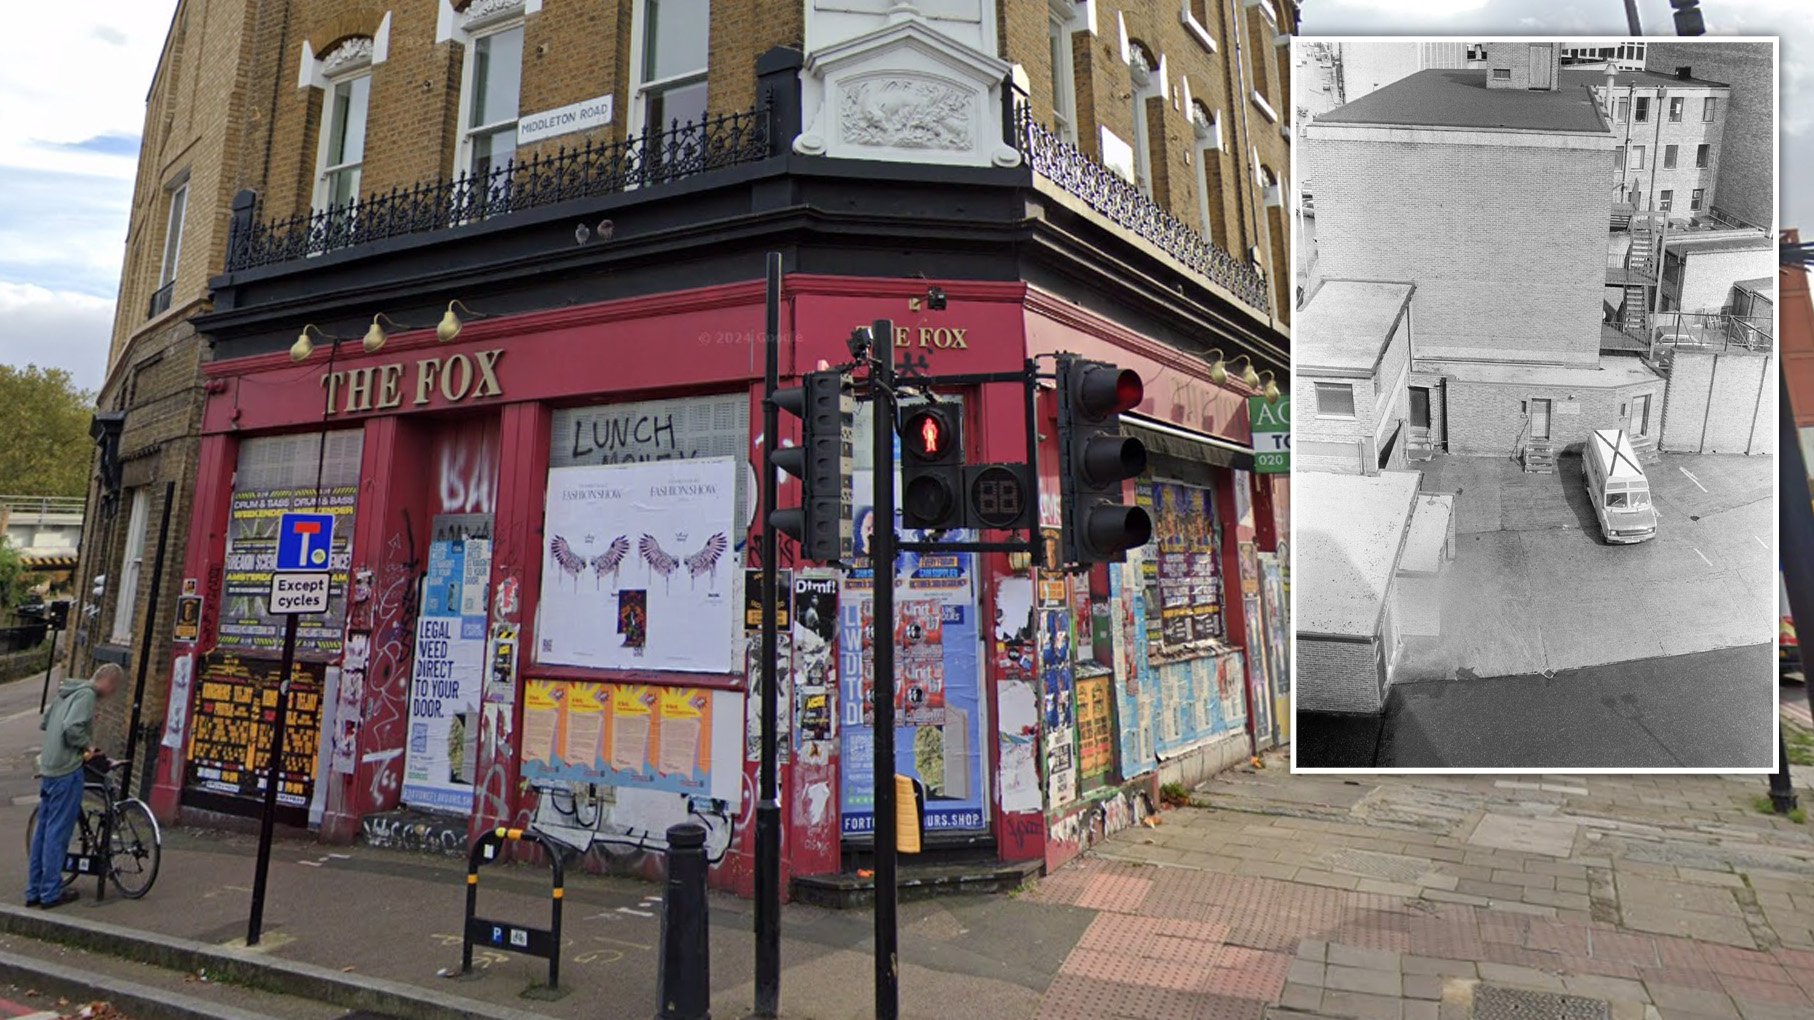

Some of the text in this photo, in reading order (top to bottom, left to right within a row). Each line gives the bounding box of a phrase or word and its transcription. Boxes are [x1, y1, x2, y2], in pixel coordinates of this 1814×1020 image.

[522, 104, 608, 134] MIDDLETON ROAD
[919, 327, 969, 349] FOX
[320, 348, 504, 415] THE FOX
[573, 414, 676, 459] LUNCH
[1259, 455, 1284, 466] 020
[278, 579, 324, 592] Except
[278, 594, 320, 608] cycles
[419, 620, 452, 640] LEGAL
[416, 660, 454, 678] DIRECT
[414, 679, 460, 699] TO YOUR
[413, 699, 445, 718] DOOR.
